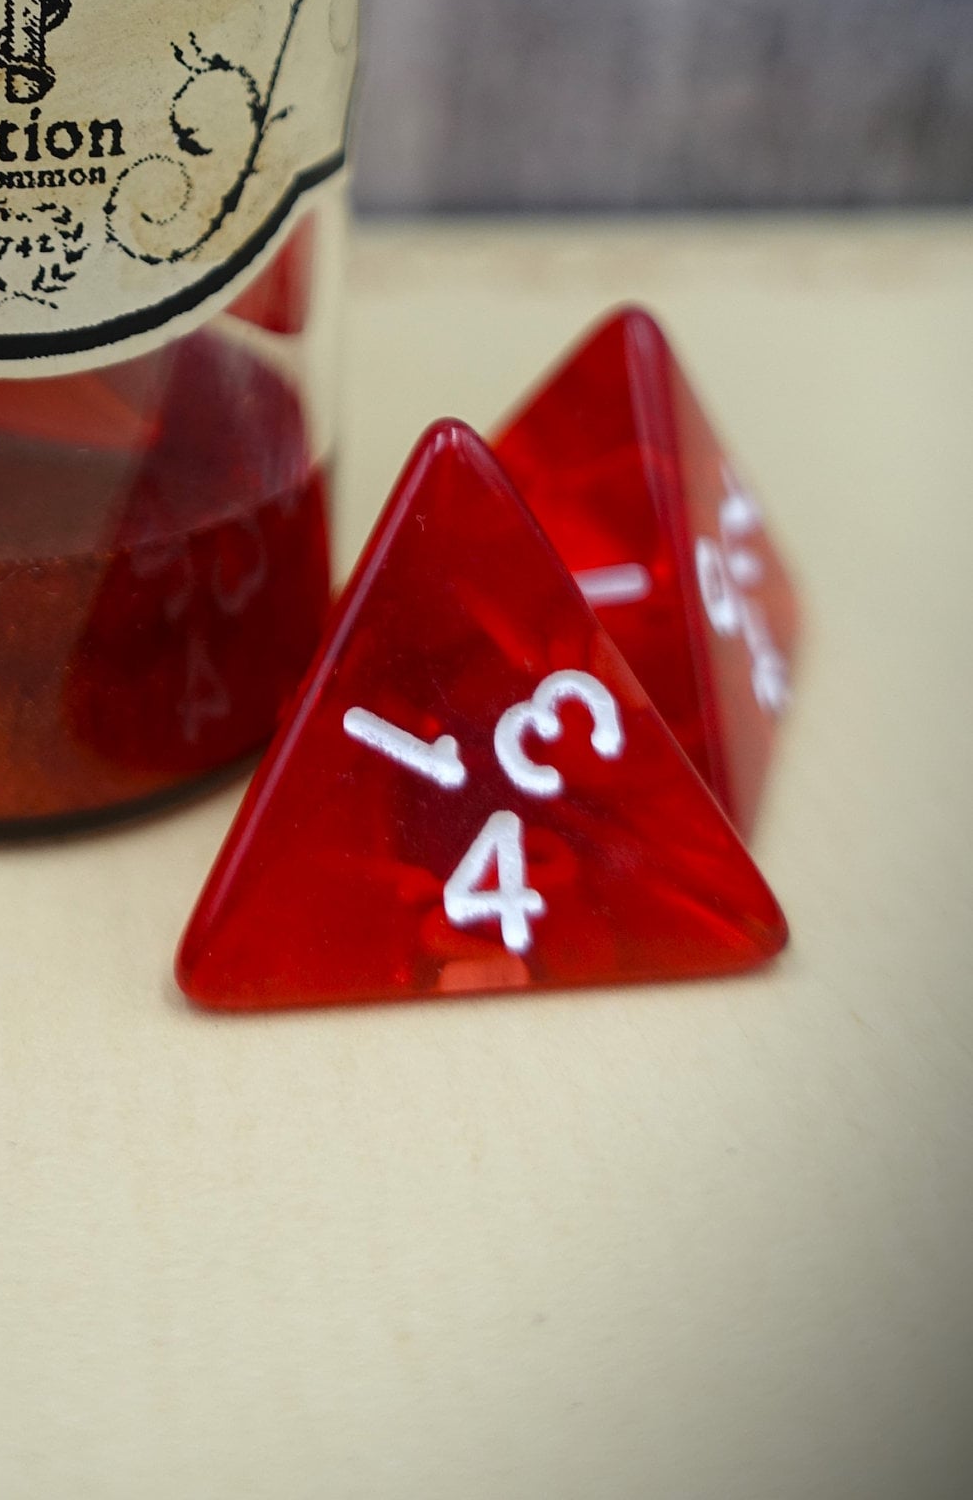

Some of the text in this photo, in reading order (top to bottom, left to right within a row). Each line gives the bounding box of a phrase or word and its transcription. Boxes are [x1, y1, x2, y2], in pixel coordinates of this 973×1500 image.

[342, 705, 467, 789] 1
[493, 668, 624, 798] 3
[443, 809, 546, 954] 4
